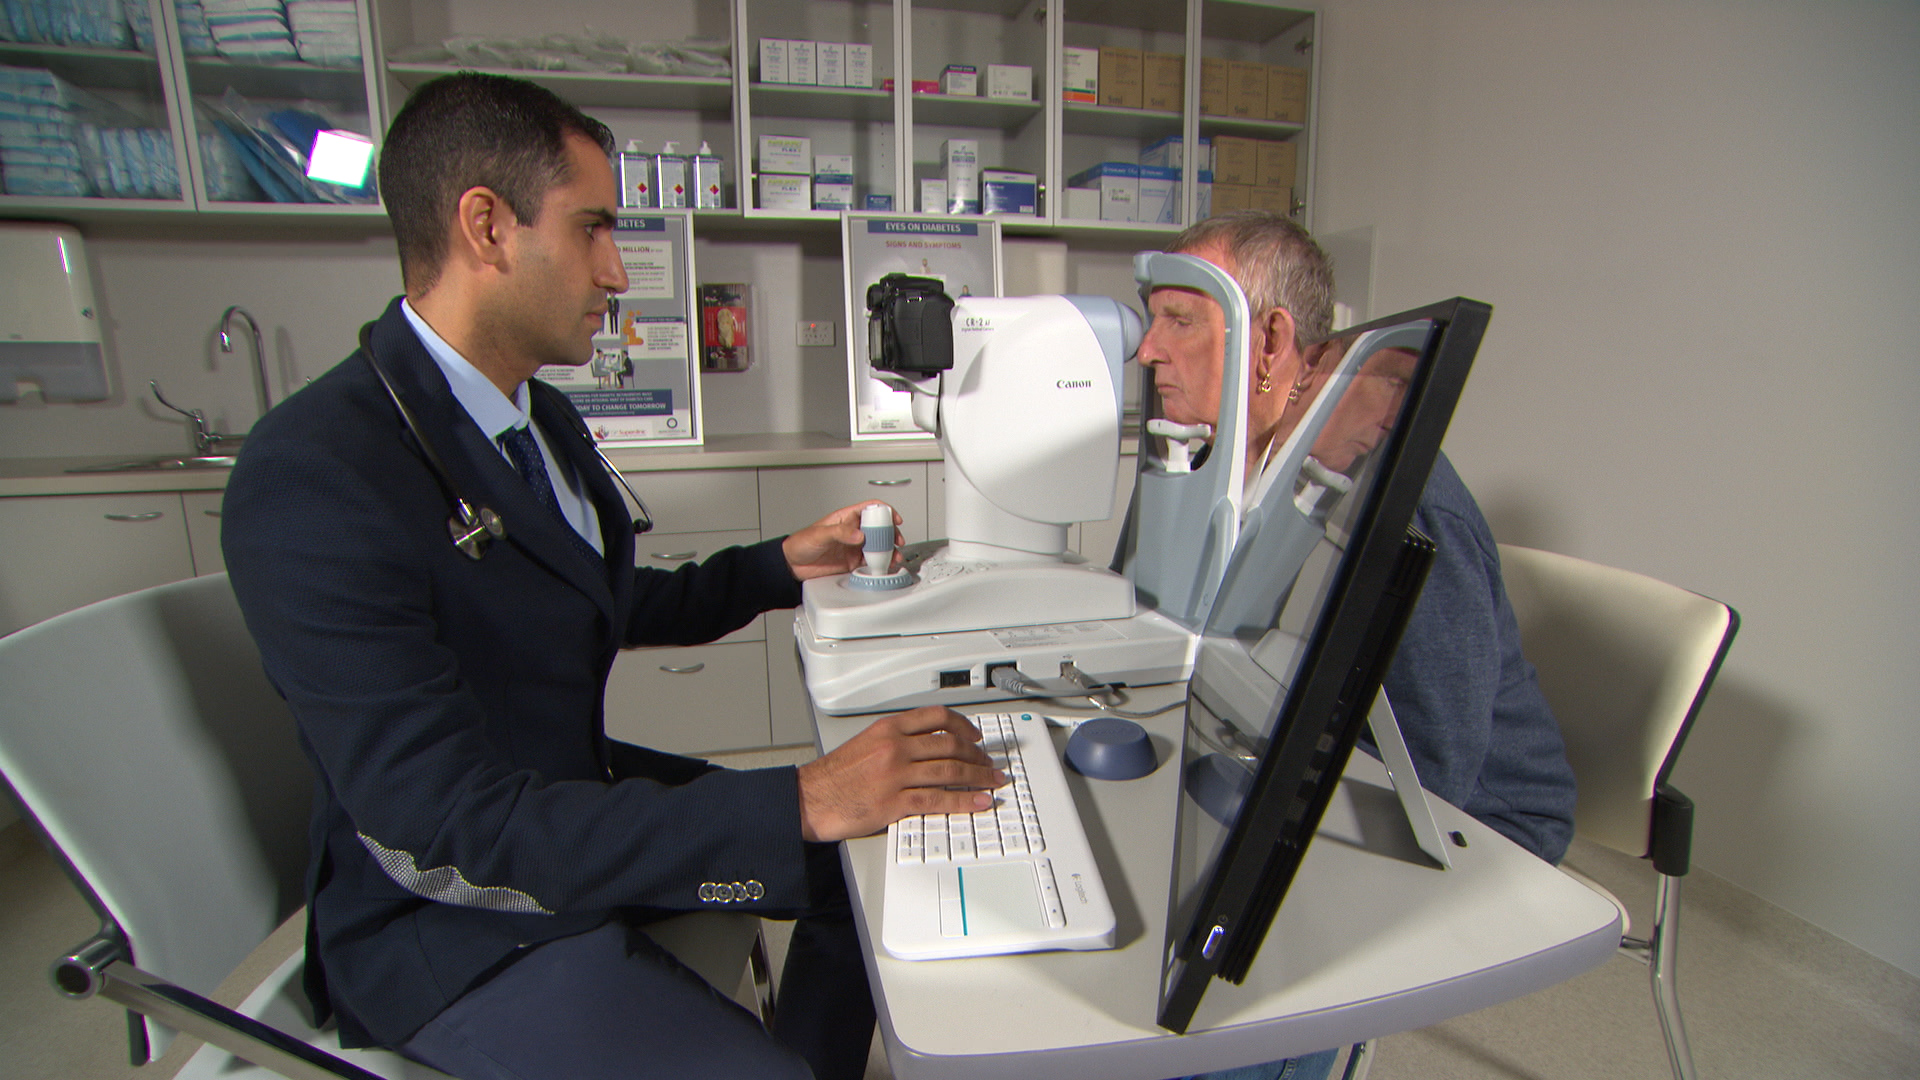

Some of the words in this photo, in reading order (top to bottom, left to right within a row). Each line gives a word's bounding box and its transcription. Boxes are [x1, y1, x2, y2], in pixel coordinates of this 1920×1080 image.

[617, 219, 646, 229] BETES
[885, 222, 906, 231] EYES
[907, 223, 920, 231] ON
[922, 223, 961, 232] DIABETES
[885, 240, 907, 248] SIGNS
[908, 241, 923, 249] AND
[924, 241, 962, 249] SYMPTOMS
[965, 317, 983, 327] CR-2
[1056, 379, 1092, 390] Canon
[628, 402, 666, 410] TOMORROW
